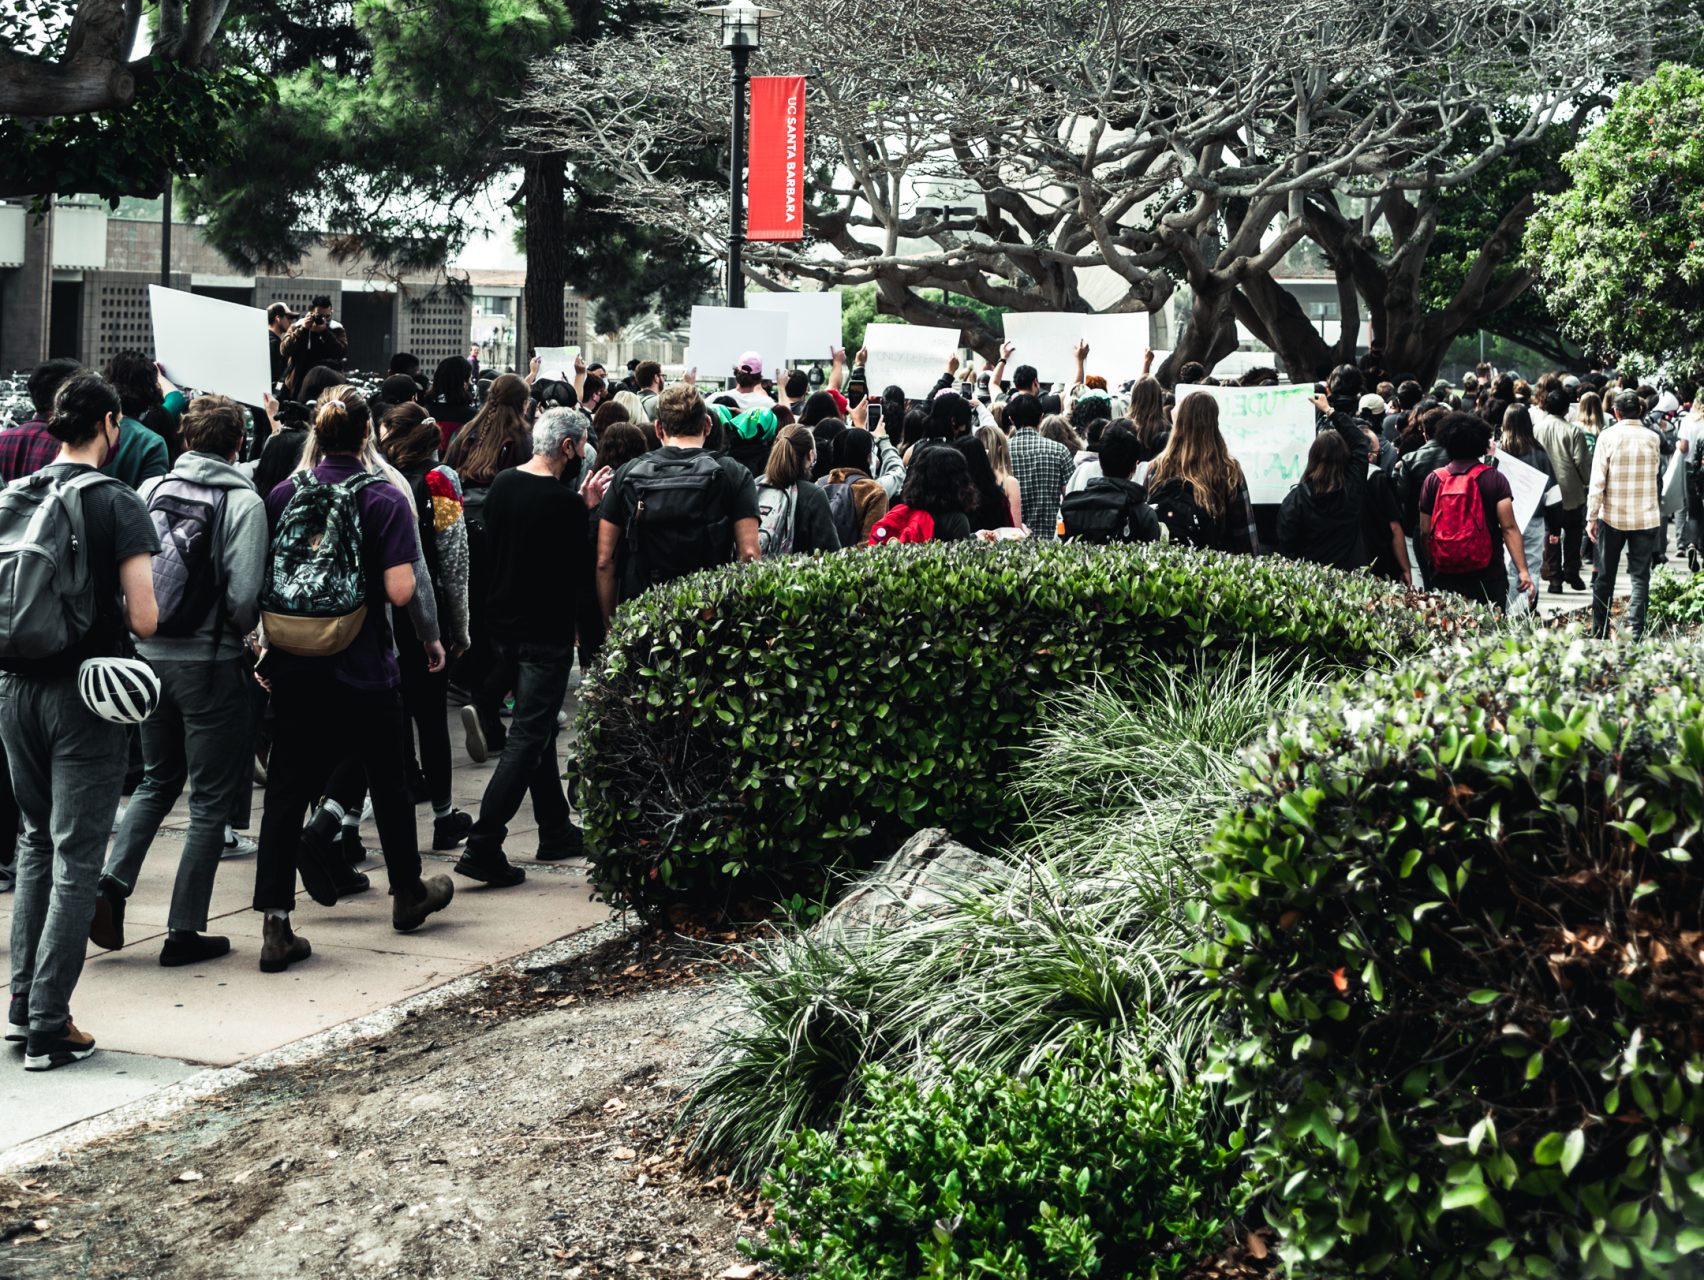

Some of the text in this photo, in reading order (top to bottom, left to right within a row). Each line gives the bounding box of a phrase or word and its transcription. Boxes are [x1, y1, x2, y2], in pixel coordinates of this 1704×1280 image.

[786, 96, 797, 222] UC SANTA BARBARA
